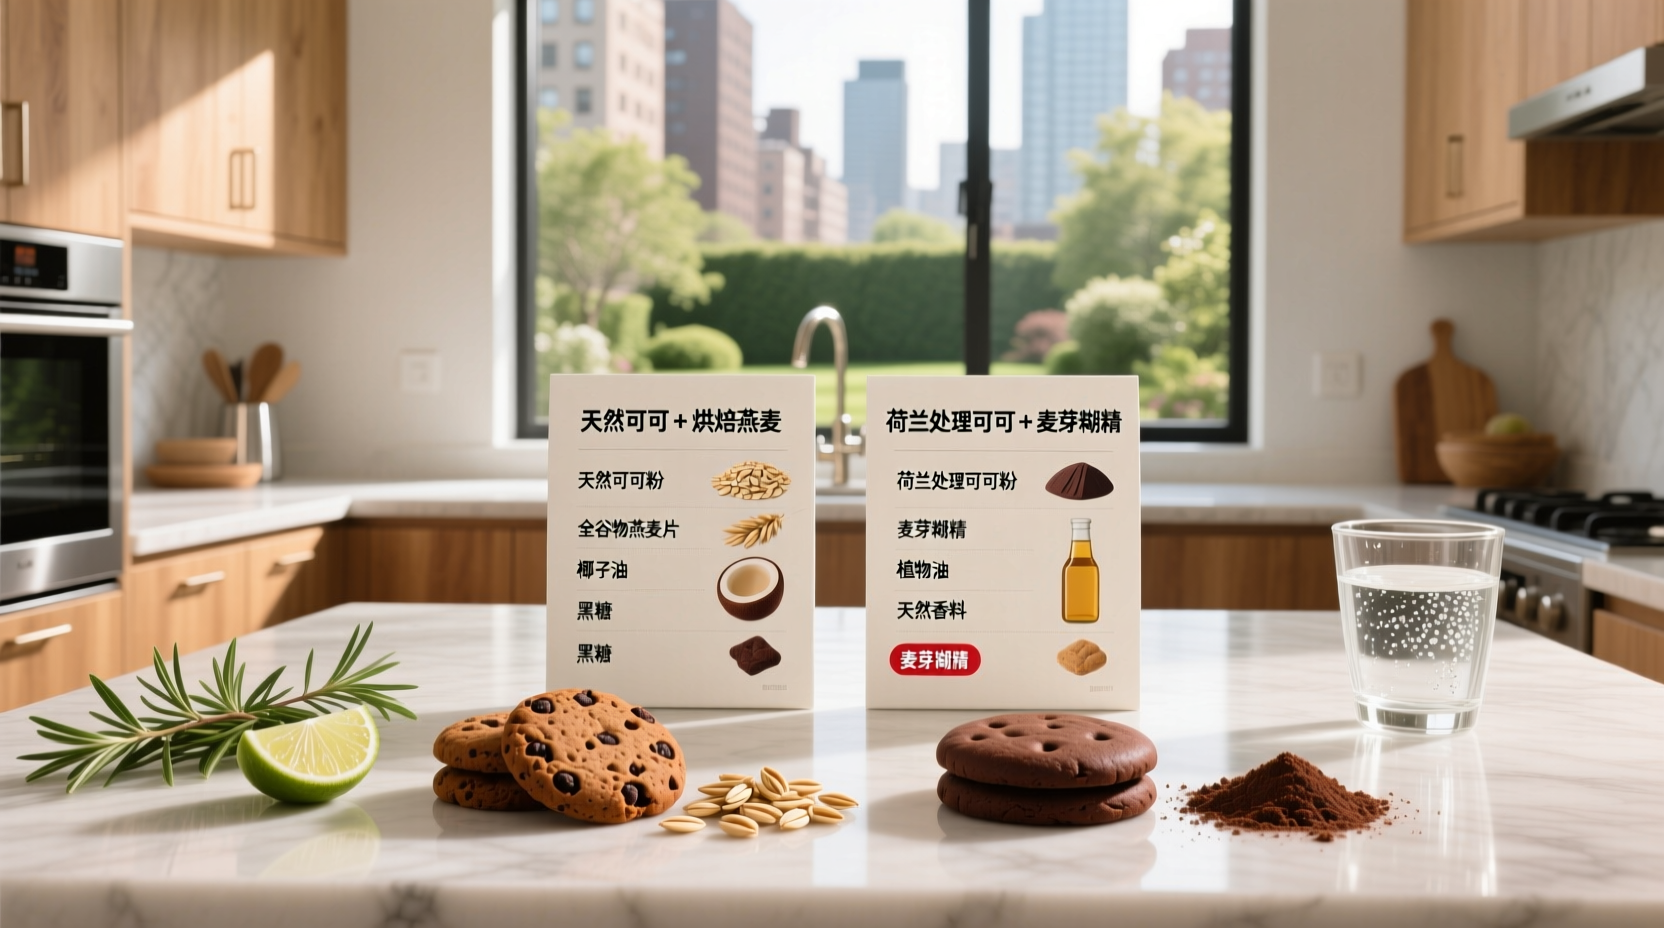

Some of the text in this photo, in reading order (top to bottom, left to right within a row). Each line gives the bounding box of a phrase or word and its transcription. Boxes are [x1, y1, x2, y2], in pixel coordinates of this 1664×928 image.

[580, 408, 782, 433] 天然可可 + 烘焙燕麦
[885, 408, 1123, 433] 荷兰处理可可 + 麦芽糊精
[577, 470, 664, 490] 天然可可粉
[896, 470, 1018, 490] 荷兰处理可可粉
[577, 519, 680, 539] 全谷物燕麦片
[576, 559, 628, 579] 椰子油
[896, 559, 949, 579] 植物油
[576, 601, 613, 621] 黑糖
[897, 600, 967, 620] 天然香料
[576, 643, 612, 664] 黑糖
